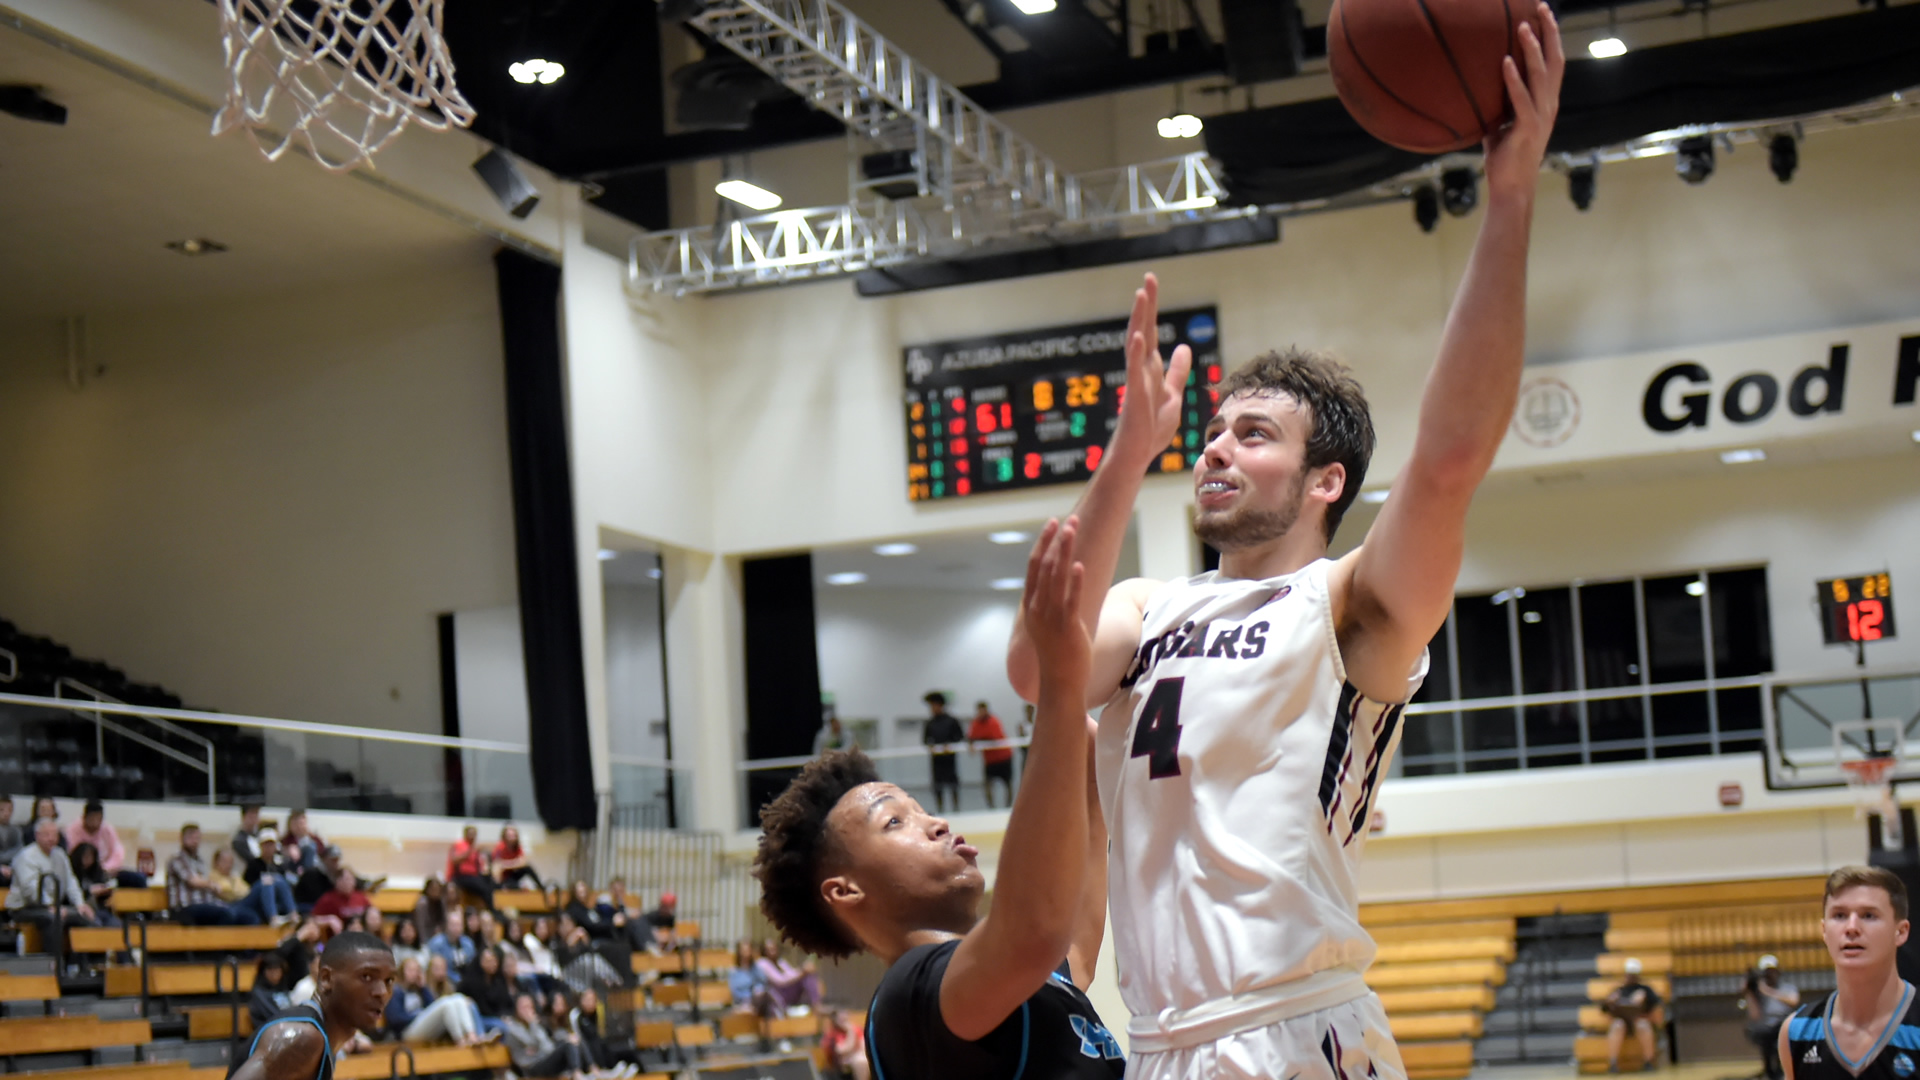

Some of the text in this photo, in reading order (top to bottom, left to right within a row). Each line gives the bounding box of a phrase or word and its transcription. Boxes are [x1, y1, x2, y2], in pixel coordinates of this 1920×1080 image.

[1079, 322, 1177, 355] COUS
[1641, 342, 1851, 435] God
[975, 402, 1013, 433] 61
[1846, 599, 1884, 641] 12
[1130, 676, 1186, 781] 4
